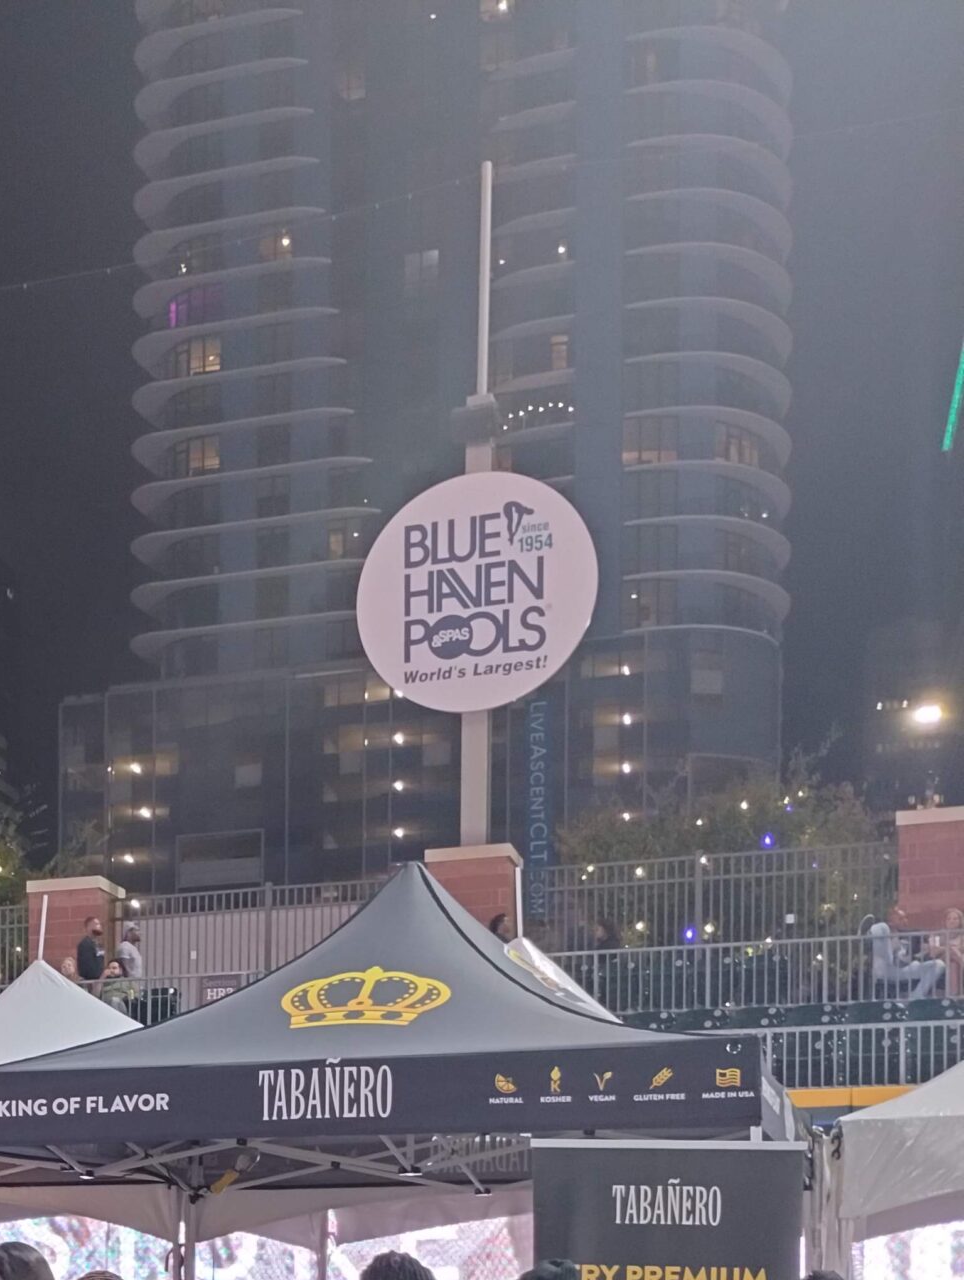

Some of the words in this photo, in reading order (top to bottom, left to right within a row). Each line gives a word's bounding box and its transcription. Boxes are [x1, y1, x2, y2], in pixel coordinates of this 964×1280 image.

[404, 512, 501, 569] BLUE
[518, 533, 553, 553] 1954
[521, 522, 550, 533] since
[404, 556, 544, 617] HAVEN
[404, 606, 547, 663] POOLS
[404, 666, 467, 684] World's
[473, 655, 548, 676] Largest!
[52, 1096, 81, 1115] OF
[86, 1093, 170, 1114] FLAVOR
[258, 1057, 393, 1122] TABAÑERO
[612, 1178, 722, 1226] TABAÑERO
